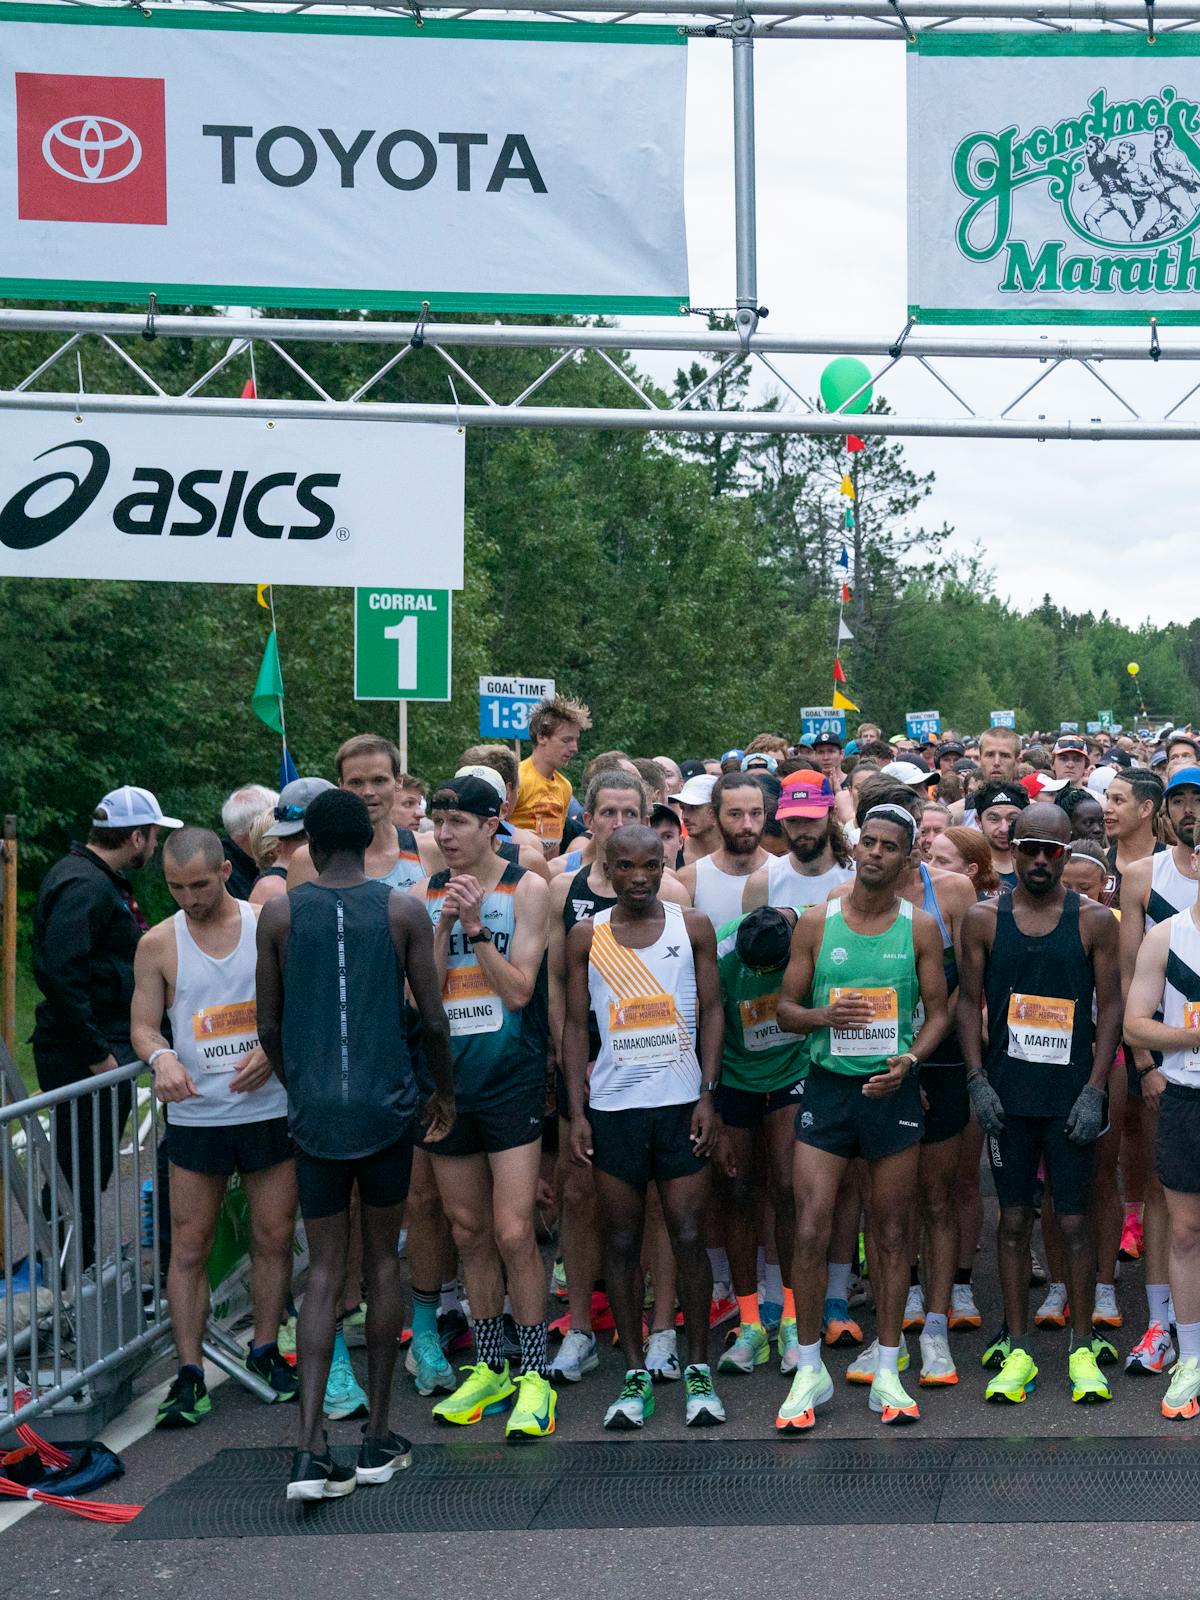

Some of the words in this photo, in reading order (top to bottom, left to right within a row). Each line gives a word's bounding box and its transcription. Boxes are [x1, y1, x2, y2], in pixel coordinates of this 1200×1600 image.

[202, 124, 549, 194] TOYOTA
[369, 593, 437, 611] CORRAL
[384, 615, 418, 690] 1
[487, 682, 516, 695] GOAL
[518, 684, 546, 697] TIME
[488, 700, 530, 730] 1:3
[805, 710, 821, 718] GOAL
[1103, 717, 1110, 727] 2
[806, 719, 842, 736] 1:40
[910, 721, 937, 734] 1:45
[447, 1004, 494, 1020] BEHLING
[612, 1032, 677, 1052] RAMAKONGOANA
[1024, 1034, 1069, 1050] MARTIN
